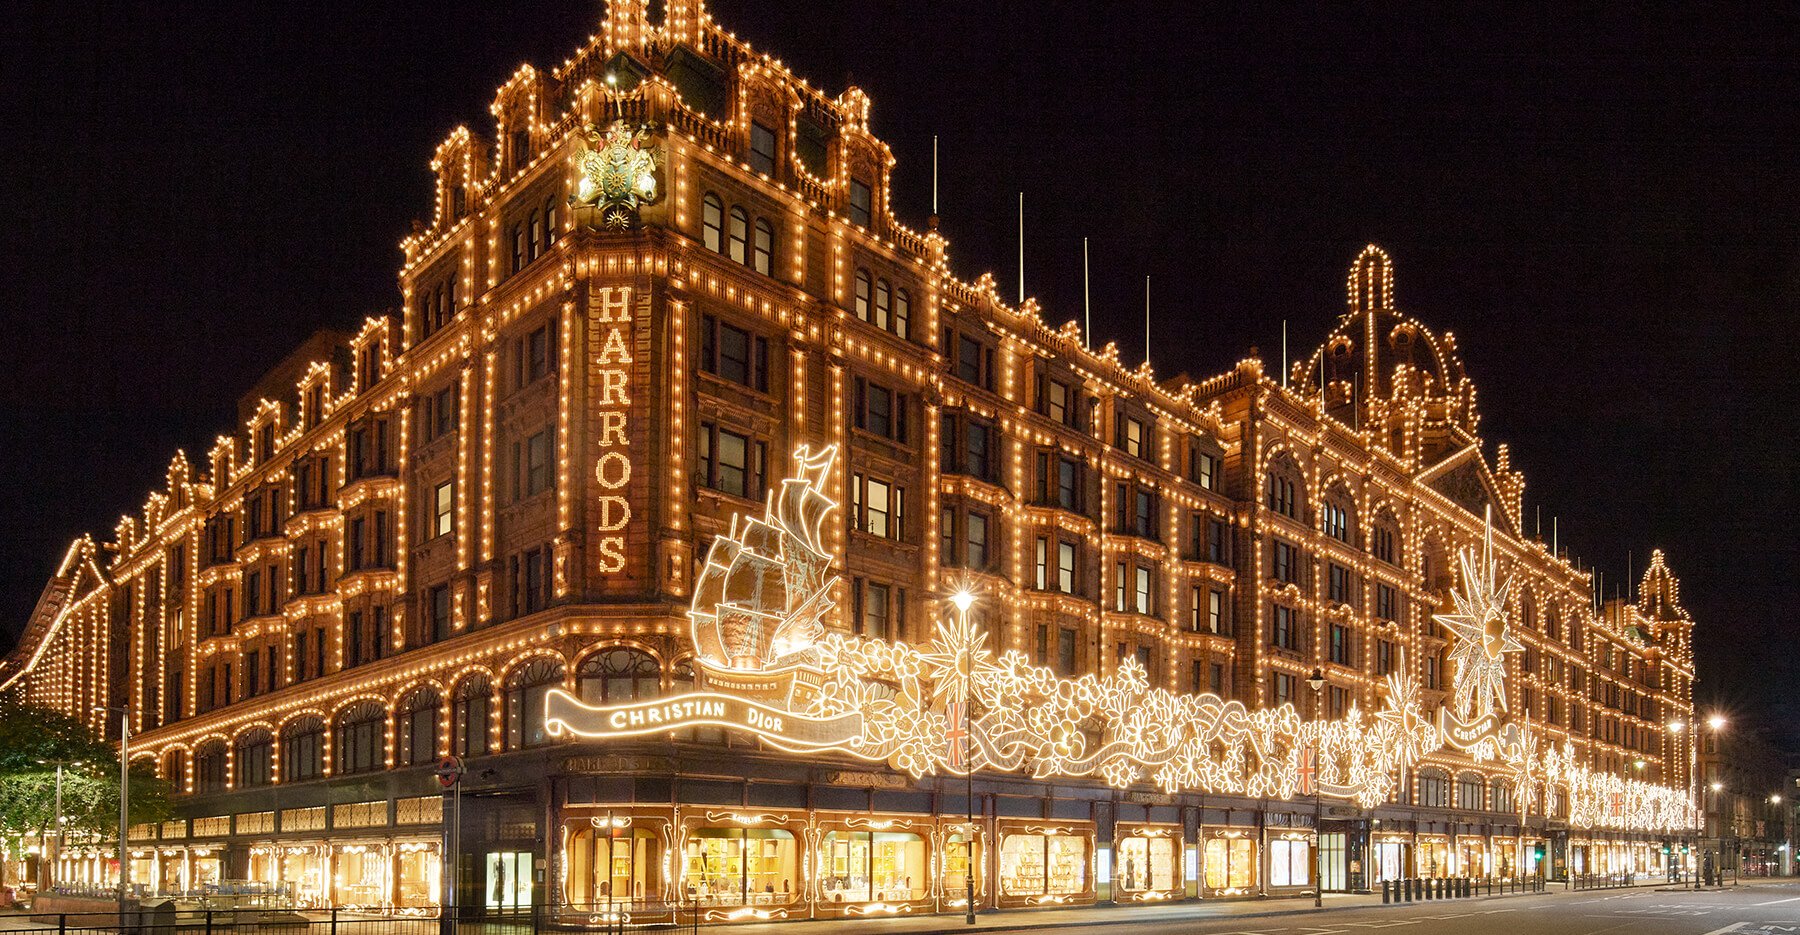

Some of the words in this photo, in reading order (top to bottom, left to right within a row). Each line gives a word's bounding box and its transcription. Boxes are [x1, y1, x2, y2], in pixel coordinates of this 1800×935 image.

[595, 286, 632, 573] HARRODS
[609, 703, 724, 729] CHRISTIAN
[746, 708, 783, 732] DIOR
